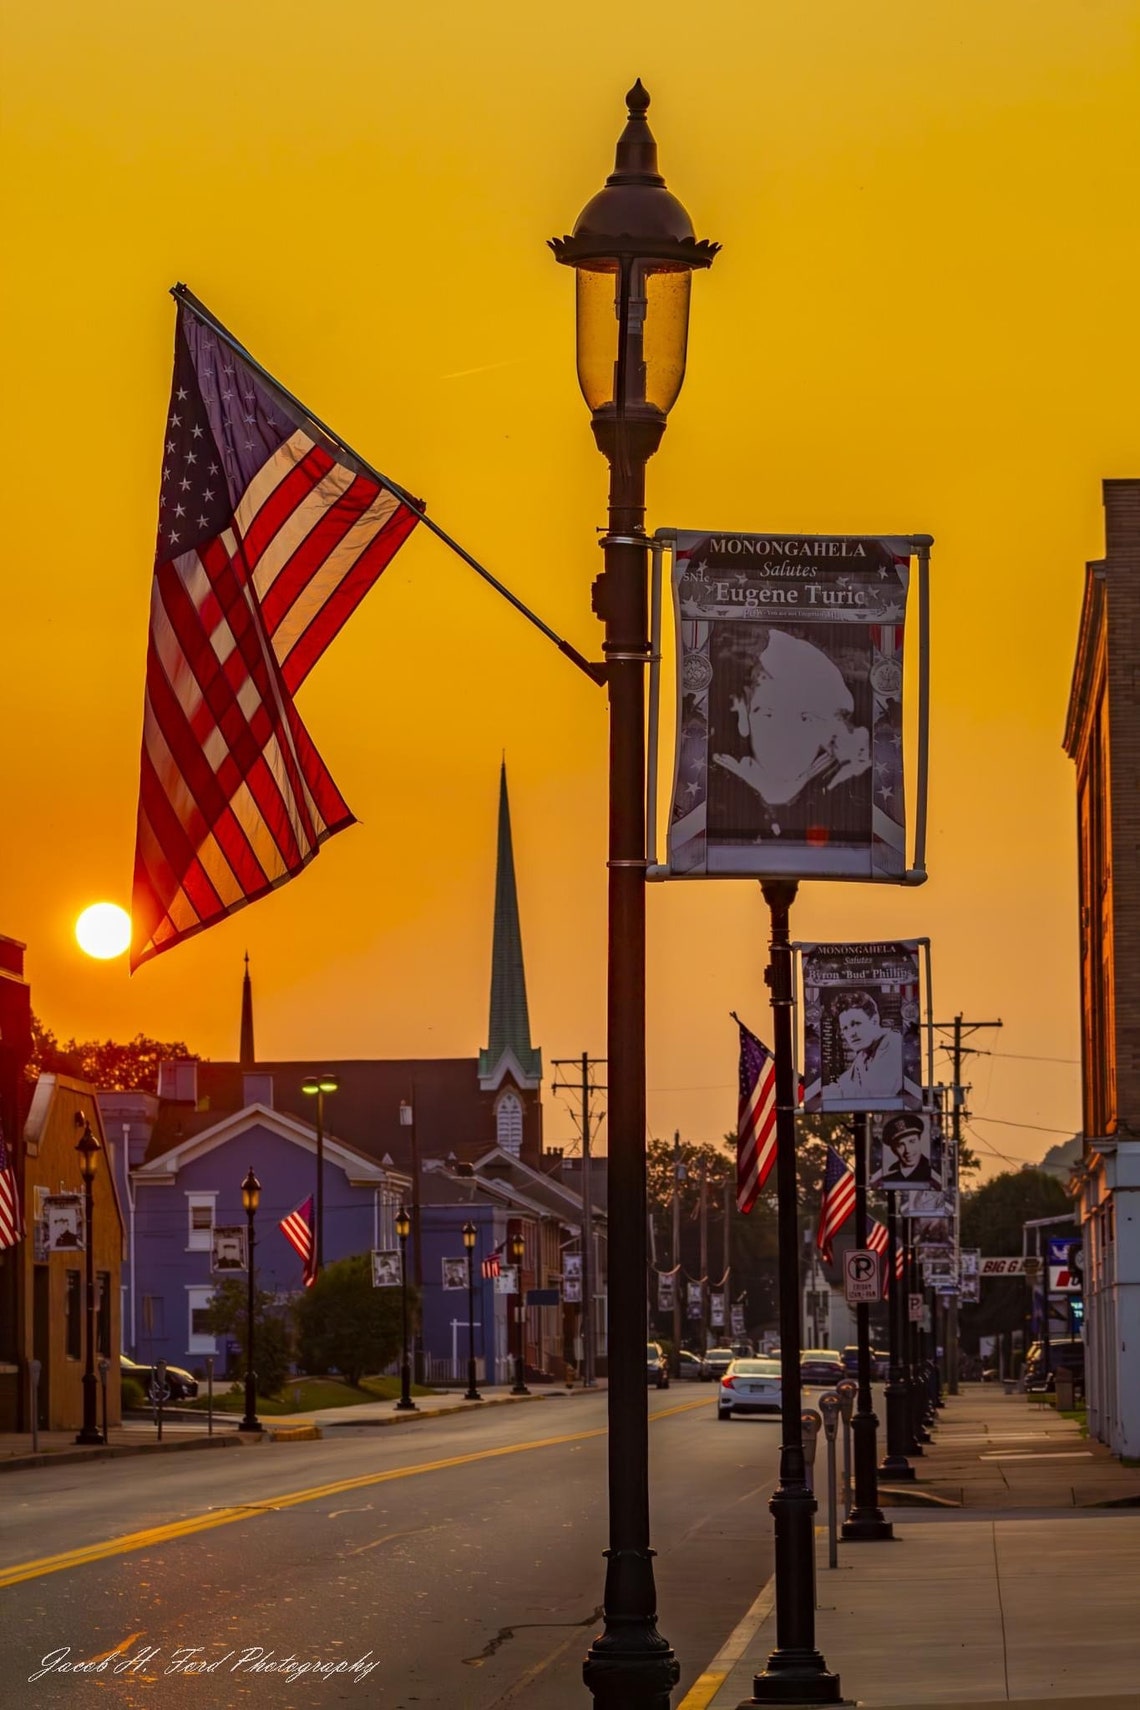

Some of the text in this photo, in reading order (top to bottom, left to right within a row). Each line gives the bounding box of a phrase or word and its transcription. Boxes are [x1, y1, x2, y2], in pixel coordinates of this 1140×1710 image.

[709, 538, 867, 558] MONONGAHELA
[759, 560, 818, 578] Salutes
[715, 581, 866, 607] Eugene Turic
[817, 945, 897, 954] MONONGAHELA
[843, 956, 873, 965] Salutes
[808, 969, 840, 983] Byron
[841, 969, 870, 979] "Bud"
[983, 1260, 1006, 1273] BIG
